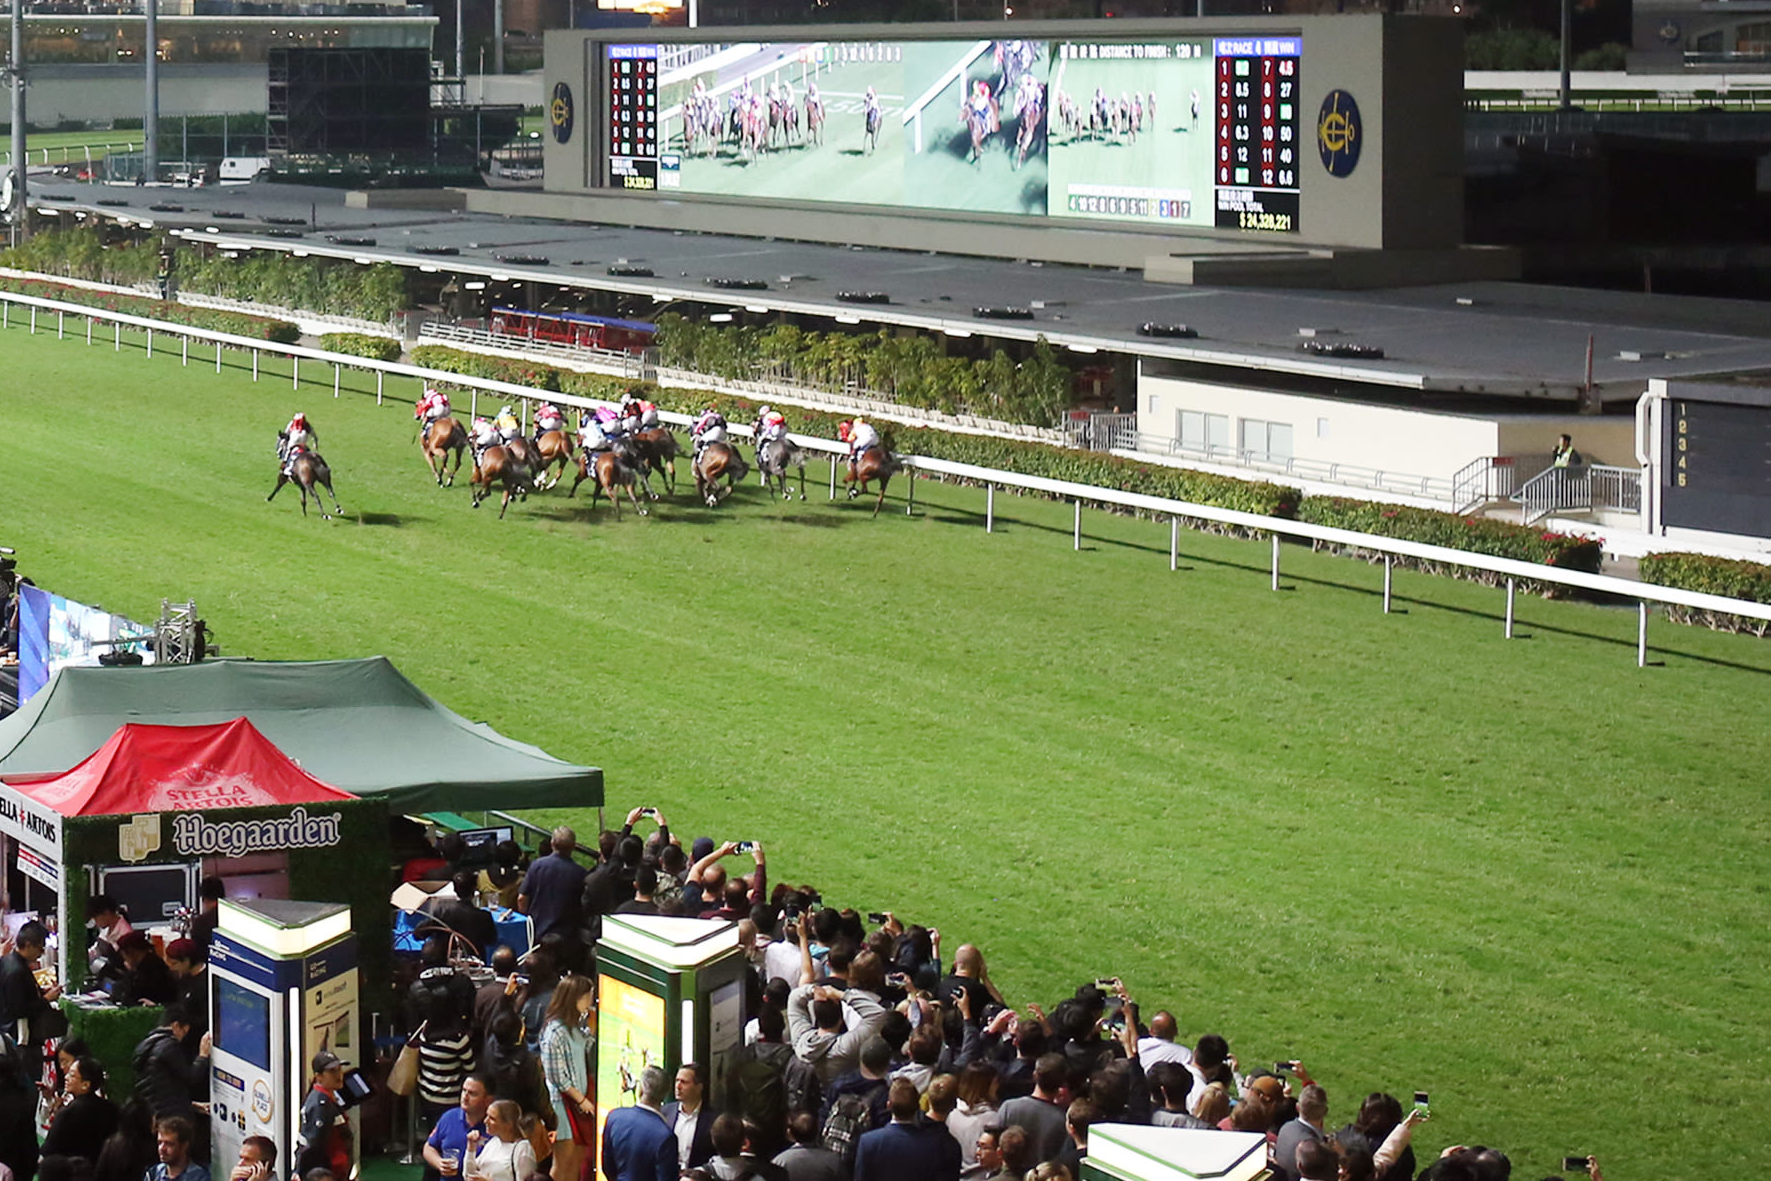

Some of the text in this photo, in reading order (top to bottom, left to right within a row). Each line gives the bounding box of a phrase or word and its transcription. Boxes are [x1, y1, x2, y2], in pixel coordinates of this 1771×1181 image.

[1222, 60, 1228, 76] 1
[1264, 60, 1271, 76] 7
[1221, 81, 1228, 97] 2
[1264, 81, 1271, 98] 8
[1280, 81, 1292, 98] 27
[1221, 103, 1228, 119] 3
[1237, 103, 1247, 119] 11
[1264, 103, 1271, 119] 9
[1221, 124, 1228, 140] 4
[1262, 125, 1274, 141] 10
[1280, 125, 1292, 142] 50
[1221, 145, 1292, 164] 5 12 11 40
[1221, 167, 1228, 183] 6
[1262, 169, 1273, 185] 12
[1681, 403, 1686, 416] 1
[1678, 420, 1687, 434] 2
[1678, 437, 1687, 451] 3
[1678, 456, 1686, 469] 4
[1678, 473, 1687, 487] 5
[166, 785, 247, 801] STELLA
[26, 811, 56, 844] ARTOIS
[174, 807, 338, 857] Hoegaarden
